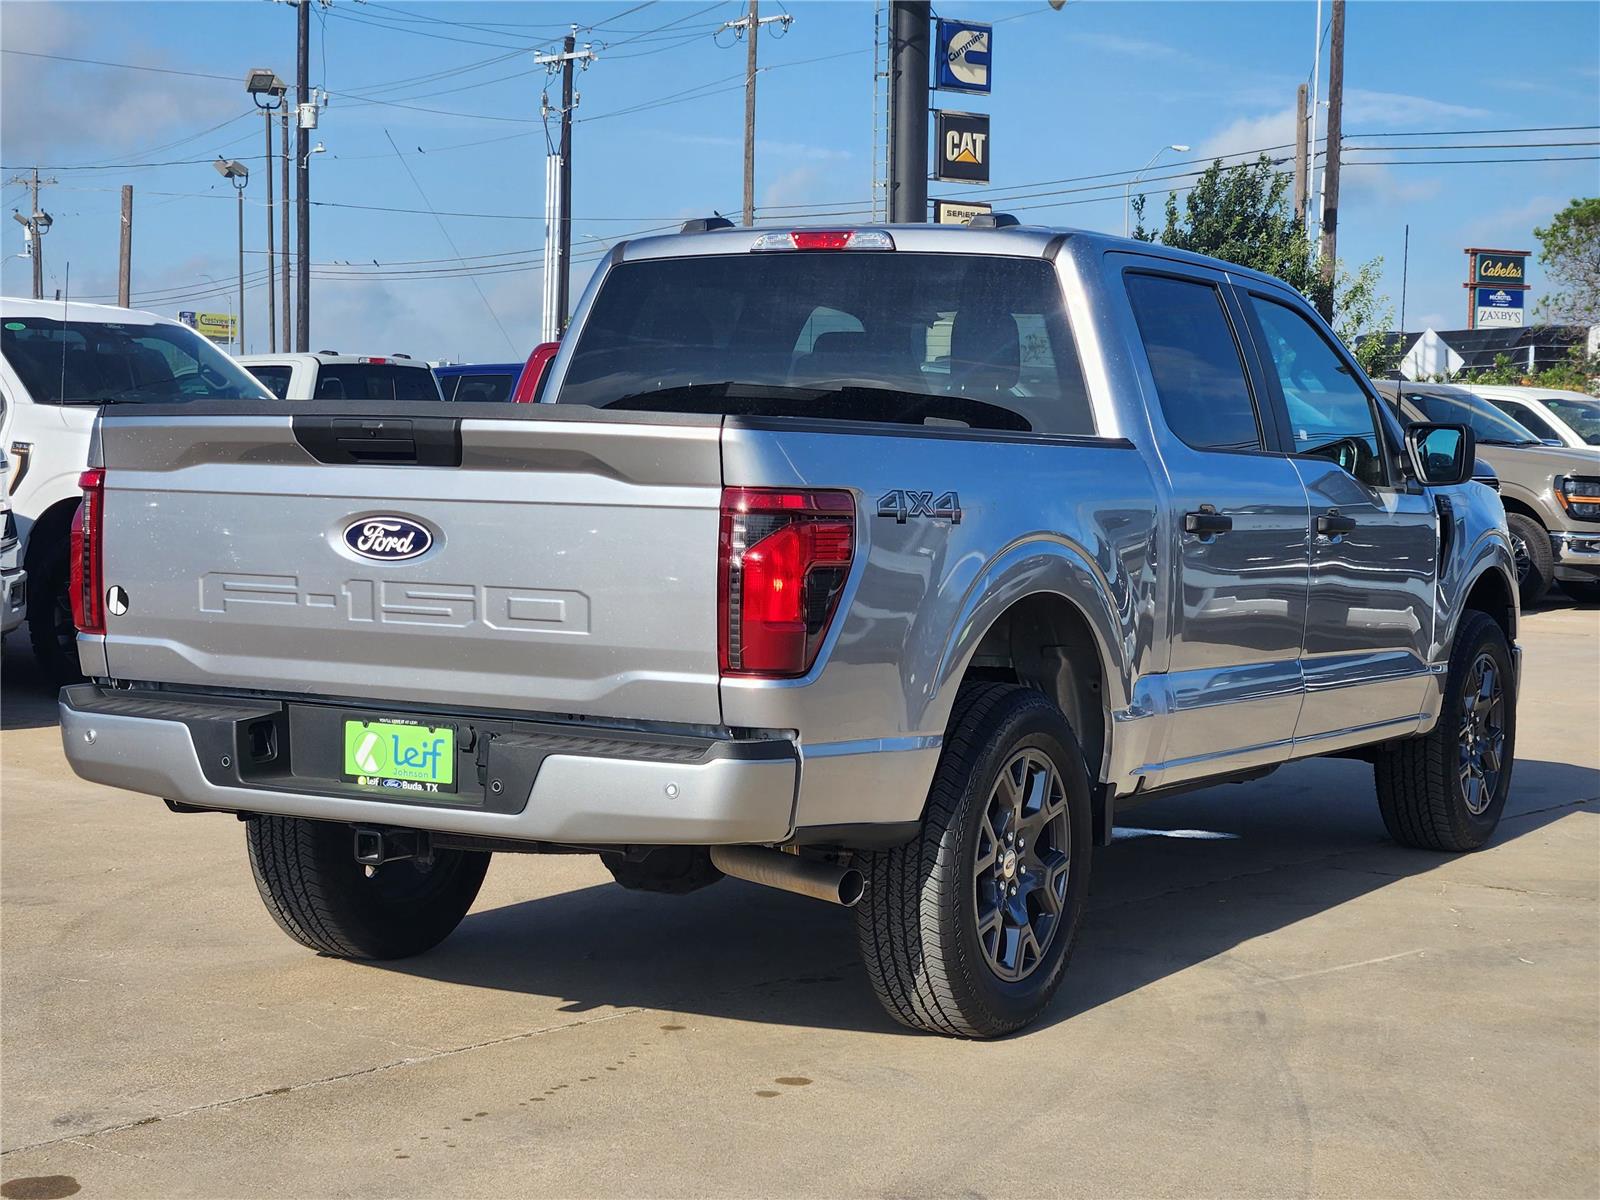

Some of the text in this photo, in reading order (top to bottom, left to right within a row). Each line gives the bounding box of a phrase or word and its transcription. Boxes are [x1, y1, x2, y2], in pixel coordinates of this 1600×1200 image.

[948, 31, 985, 62] Cummins
[946, 130, 987, 164] CAT
[1480, 260, 1523, 278] Cabela's
[1480, 310, 1521, 324] ZAXBY'S
[357, 521, 415, 556] Ford
[199, 571, 591, 635] F-150
[391, 734, 445, 779] leif
[393, 767, 429, 779] Johnson
[425, 783, 439, 793] TX
